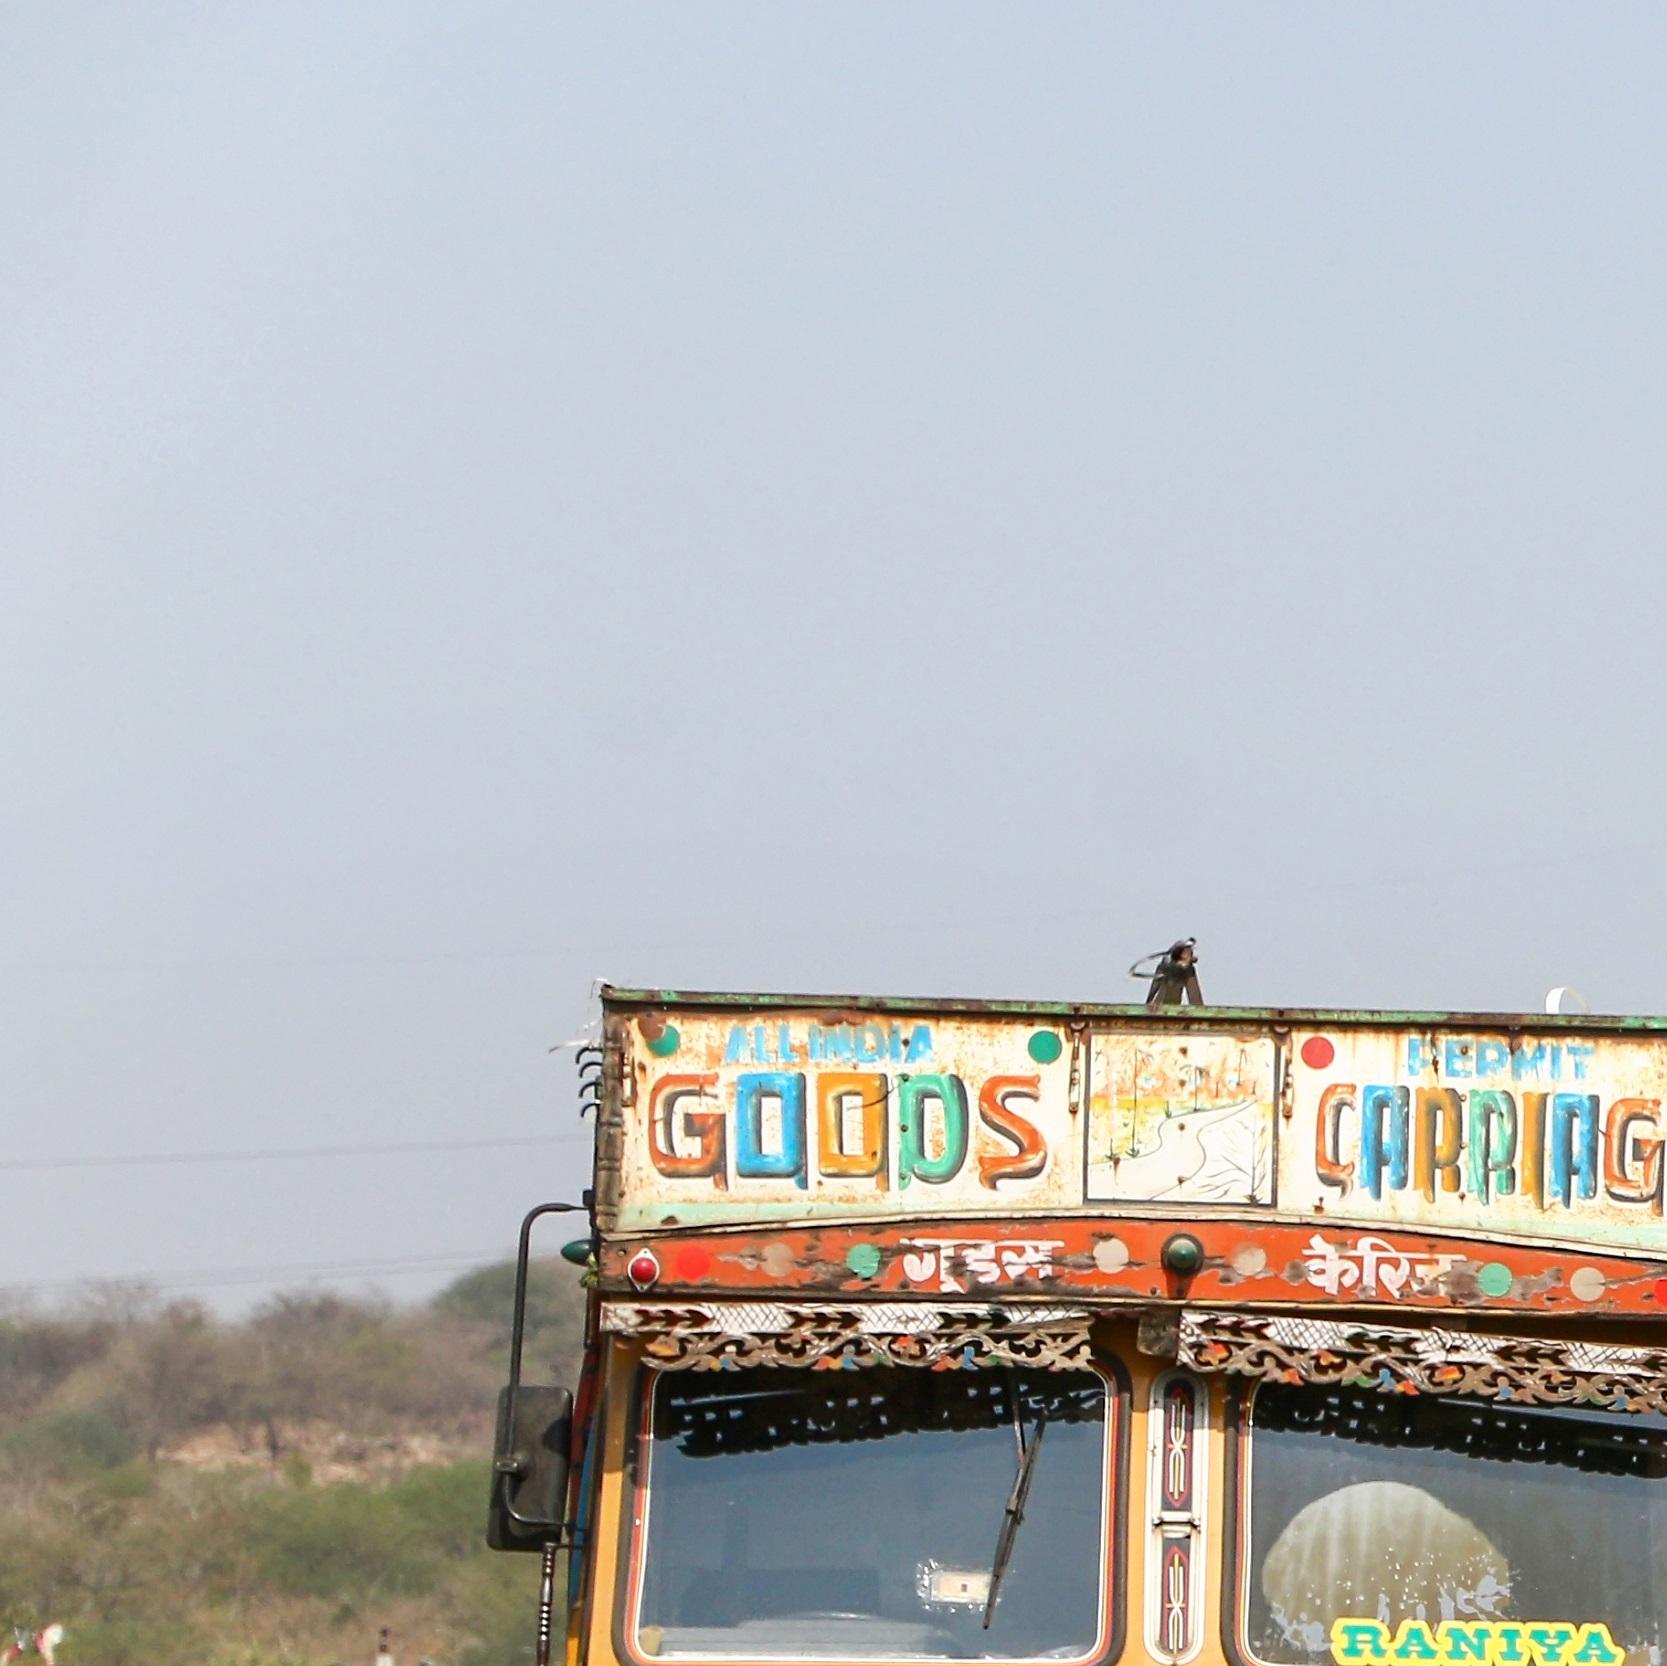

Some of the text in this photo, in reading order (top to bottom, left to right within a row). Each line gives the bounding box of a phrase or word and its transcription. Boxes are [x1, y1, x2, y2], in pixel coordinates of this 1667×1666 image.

[725, 1024, 932, 1064] ALL INDIA
[648, 1071, 1049, 1191] GOODS
[1337, 1622, 1620, 1666] RANIYA
